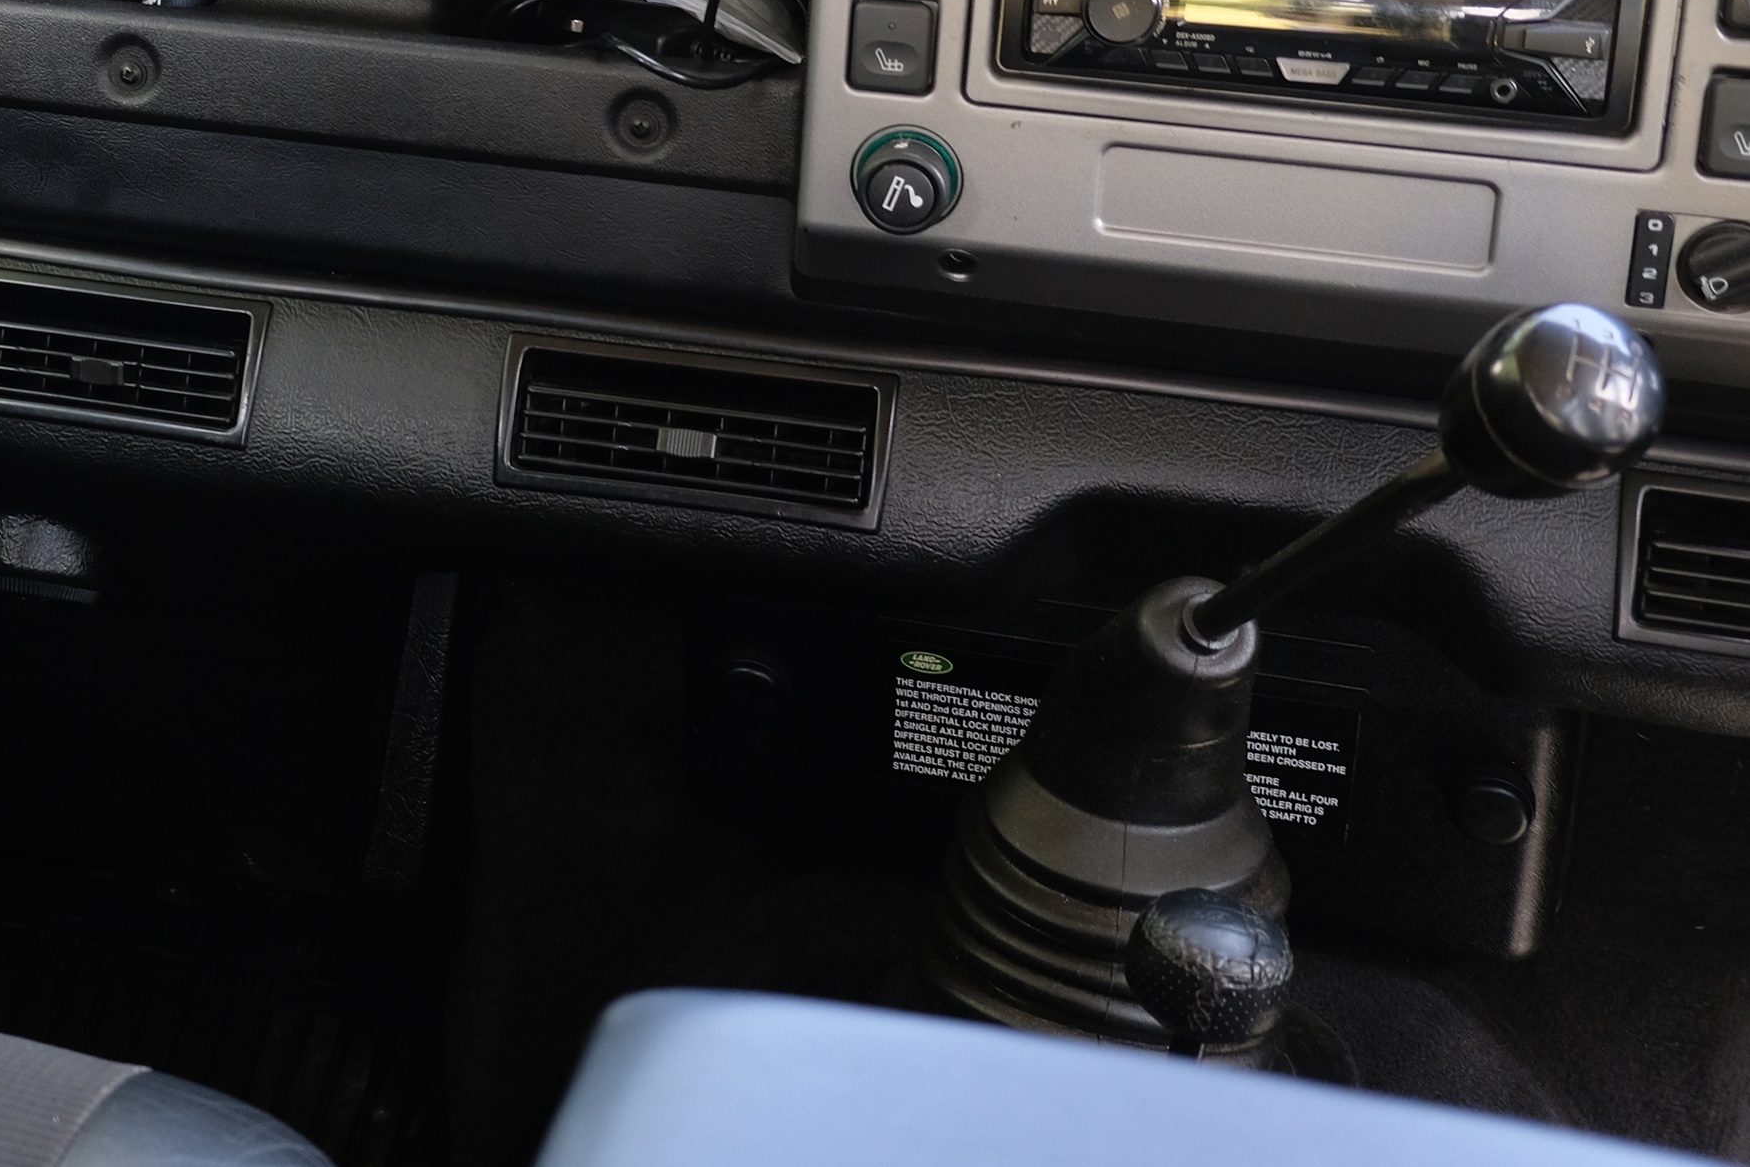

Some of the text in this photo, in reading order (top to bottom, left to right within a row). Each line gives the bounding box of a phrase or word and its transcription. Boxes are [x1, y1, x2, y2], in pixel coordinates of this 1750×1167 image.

[1291, 66, 1337, 79] MEGA BASS
[1648, 244, 1659, 256] 1
[1642, 267, 1658, 280] 2
[1639, 291, 1655, 305] 3
[912, 653, 936, 663] LAND
[913, 661, 943, 672] ROVER
[895, 709, 960, 727] DIFFERENTIAL
[962, 720, 989, 731] LOCK
[991, 724, 1016, 735] MUST
[896, 677, 915, 687] THE
[917, 680, 983, 699] DIFFERENTIAL
[985, 691, 1012, 702] LOCK
[1247, 731, 1278, 742] IKELY
[1280, 735, 1293, 745] TO
[1295, 737, 1309, 747] BE
[896, 688, 919, 699] WIDE
[921, 692, 973, 706] THROTTLE
[971, 699, 1020, 714] OPENINGS
[1270, 745, 1296, 756] WITH
[896, 699, 908, 708] 1st
[911, 701, 931, 711] AND
[932, 704, 949, 714] 2nd
[951, 707, 978, 719] GEAR
[980, 712, 1002, 722] LOW
[1247, 752, 1275, 763] BEEN
[1277, 756, 1325, 772] CROSSED
[1327, 764, 1347, 775] THE
[895, 720, 901, 728] A
[903, 722, 937, 734] SINGLE
[939, 727, 963, 737] AXLE
[966, 731, 1004, 744] ROLLER
[1243, 773, 1280, 786] ENTRE
[893, 762, 949, 778] STATIONARY
[951, 772, 976, 782] AXLE
[894, 730, 959, 748] DIFFERENTIAL
[961, 742, 987, 752] LOCK
[1251, 785, 1286, 798] EITHER
[1288, 791, 1308, 802] ALL
[1310, 794, 1338, 807] FOUR
[894, 741, 932, 754] WHEELS
[934, 747, 960, 758] MUST
[963, 752, 975, 761] BE
[1295, 803, 1312, 813] RIG
[1314, 806, 1324, 816] IS
[947, 759, 965, 770] THE
[1269, 810, 1302, 823] SHAFT
[1303, 815, 1317, 825] TO
